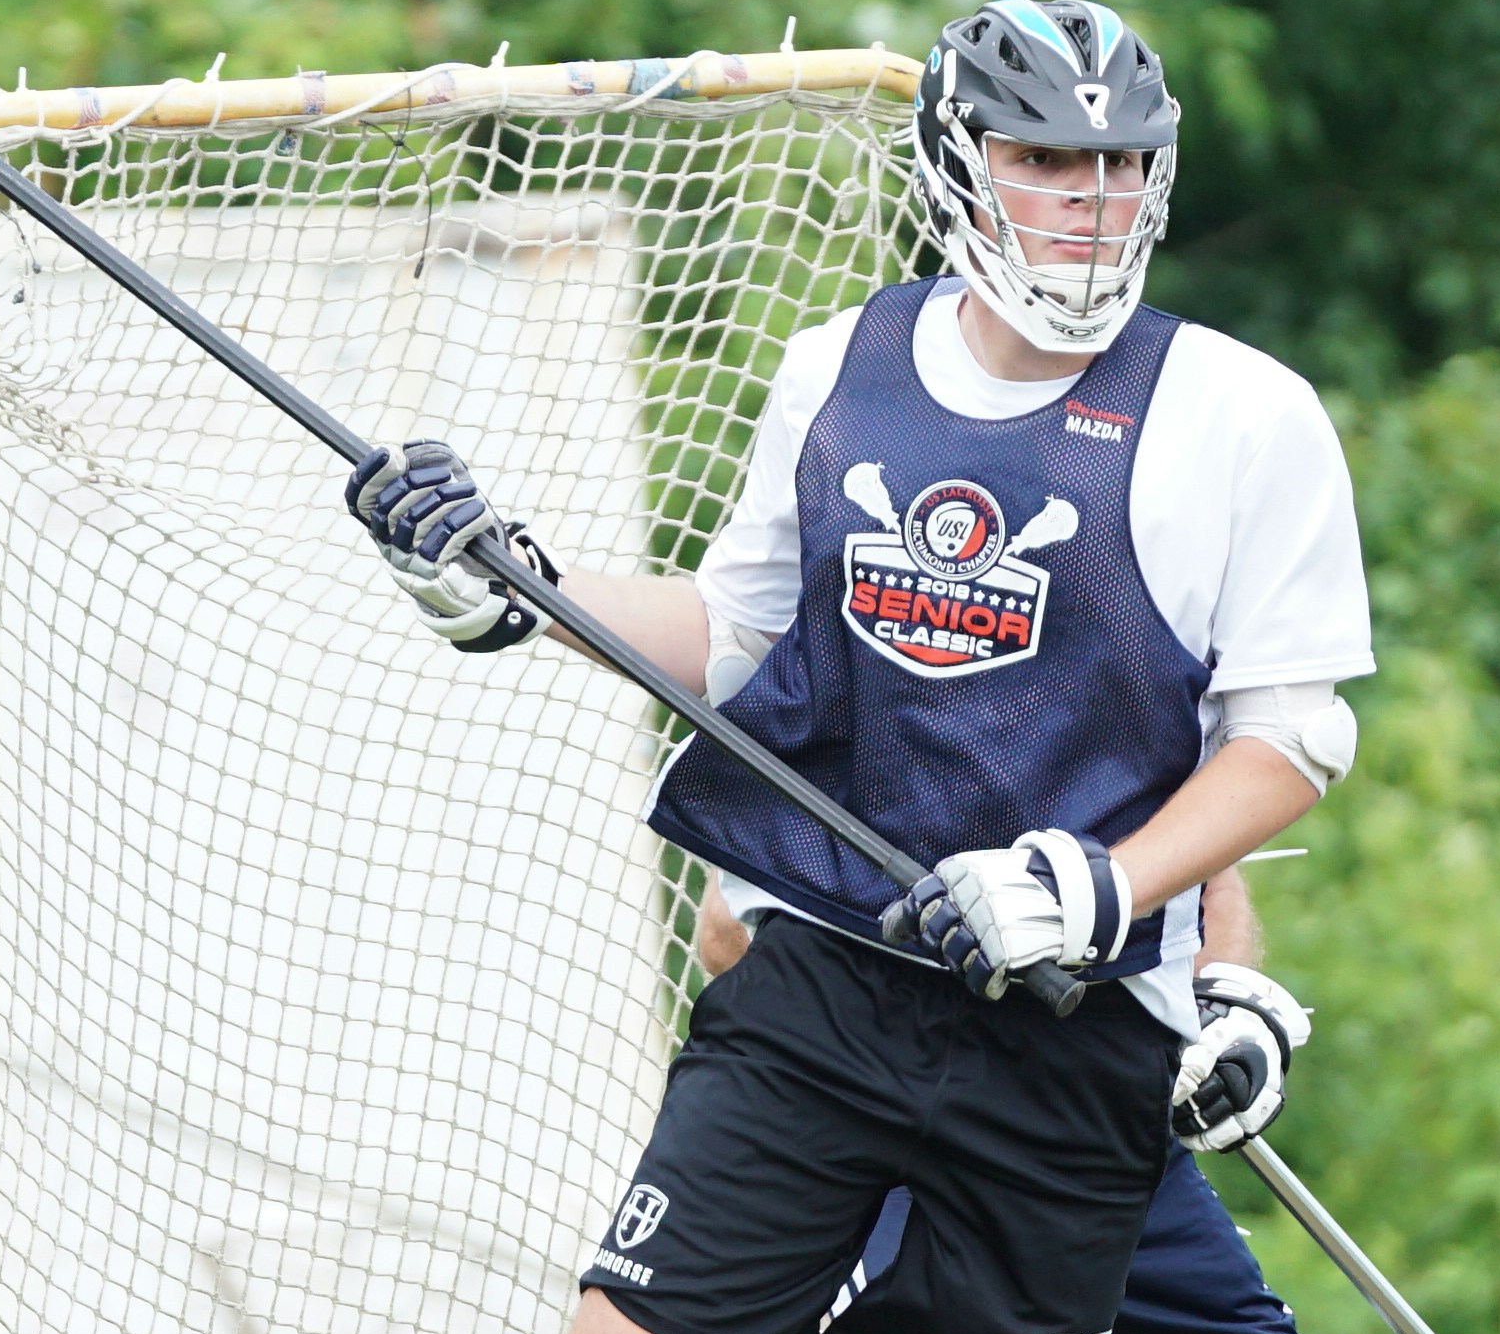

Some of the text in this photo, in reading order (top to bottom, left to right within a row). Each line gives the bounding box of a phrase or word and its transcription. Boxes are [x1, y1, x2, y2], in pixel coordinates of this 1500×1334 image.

[1065, 415, 1122, 444] MAZDA
[925, 487, 994, 518] US LACROSSE
[912, 520, 998, 574] RICHMOND CHAPTER
[916, 576, 971, 600] 2018
[851, 581, 1030, 646] SENIOR
[874, 620, 994, 658] CLASSIC
